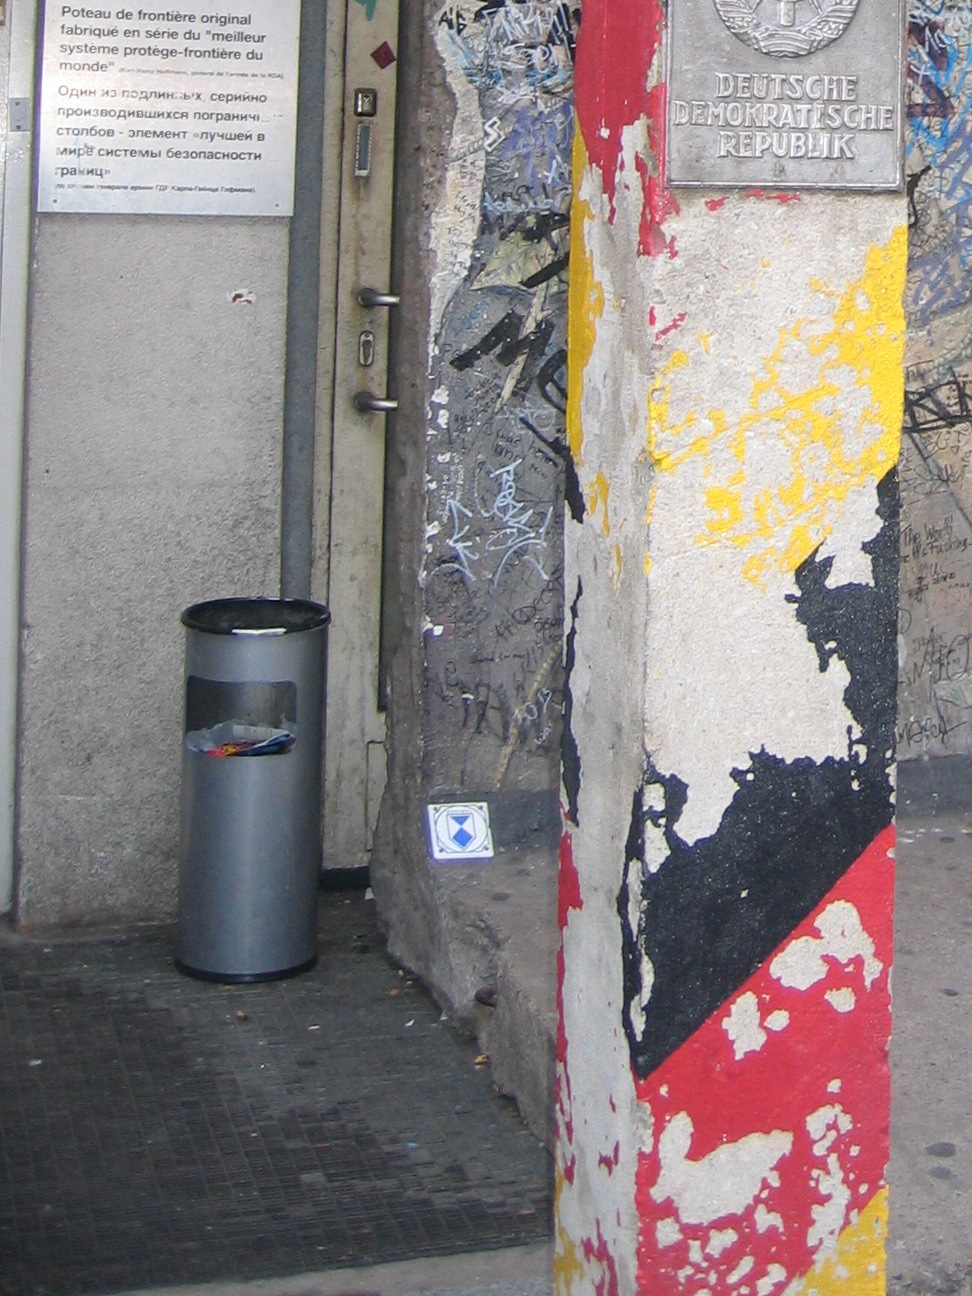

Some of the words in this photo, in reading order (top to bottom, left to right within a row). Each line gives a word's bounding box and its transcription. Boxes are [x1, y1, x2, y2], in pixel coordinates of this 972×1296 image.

[61, 4, 111, 19] Poteau
[115, 7, 133, 19] de
[137, 8, 196, 22] frontière
[200, 11, 251, 26] original
[60, 22, 119, 39] fabriqué
[122, 28, 140, 38] en
[144, 26, 179, 39] série
[183, 27, 200, 40] du
[205, 28, 266, 43] "meilleur
[59, 41, 119, 55] système
[123, 43, 241, 59] protège-frontière
[245, 47, 263, 60] du
[58, 58, 115, 71] monde"
[715, 72, 857, 101] DEUTSCHE
[672, 100, 894, 131] DEMOKRATISCHE
[718, 130, 856, 160] REPUBLIK
